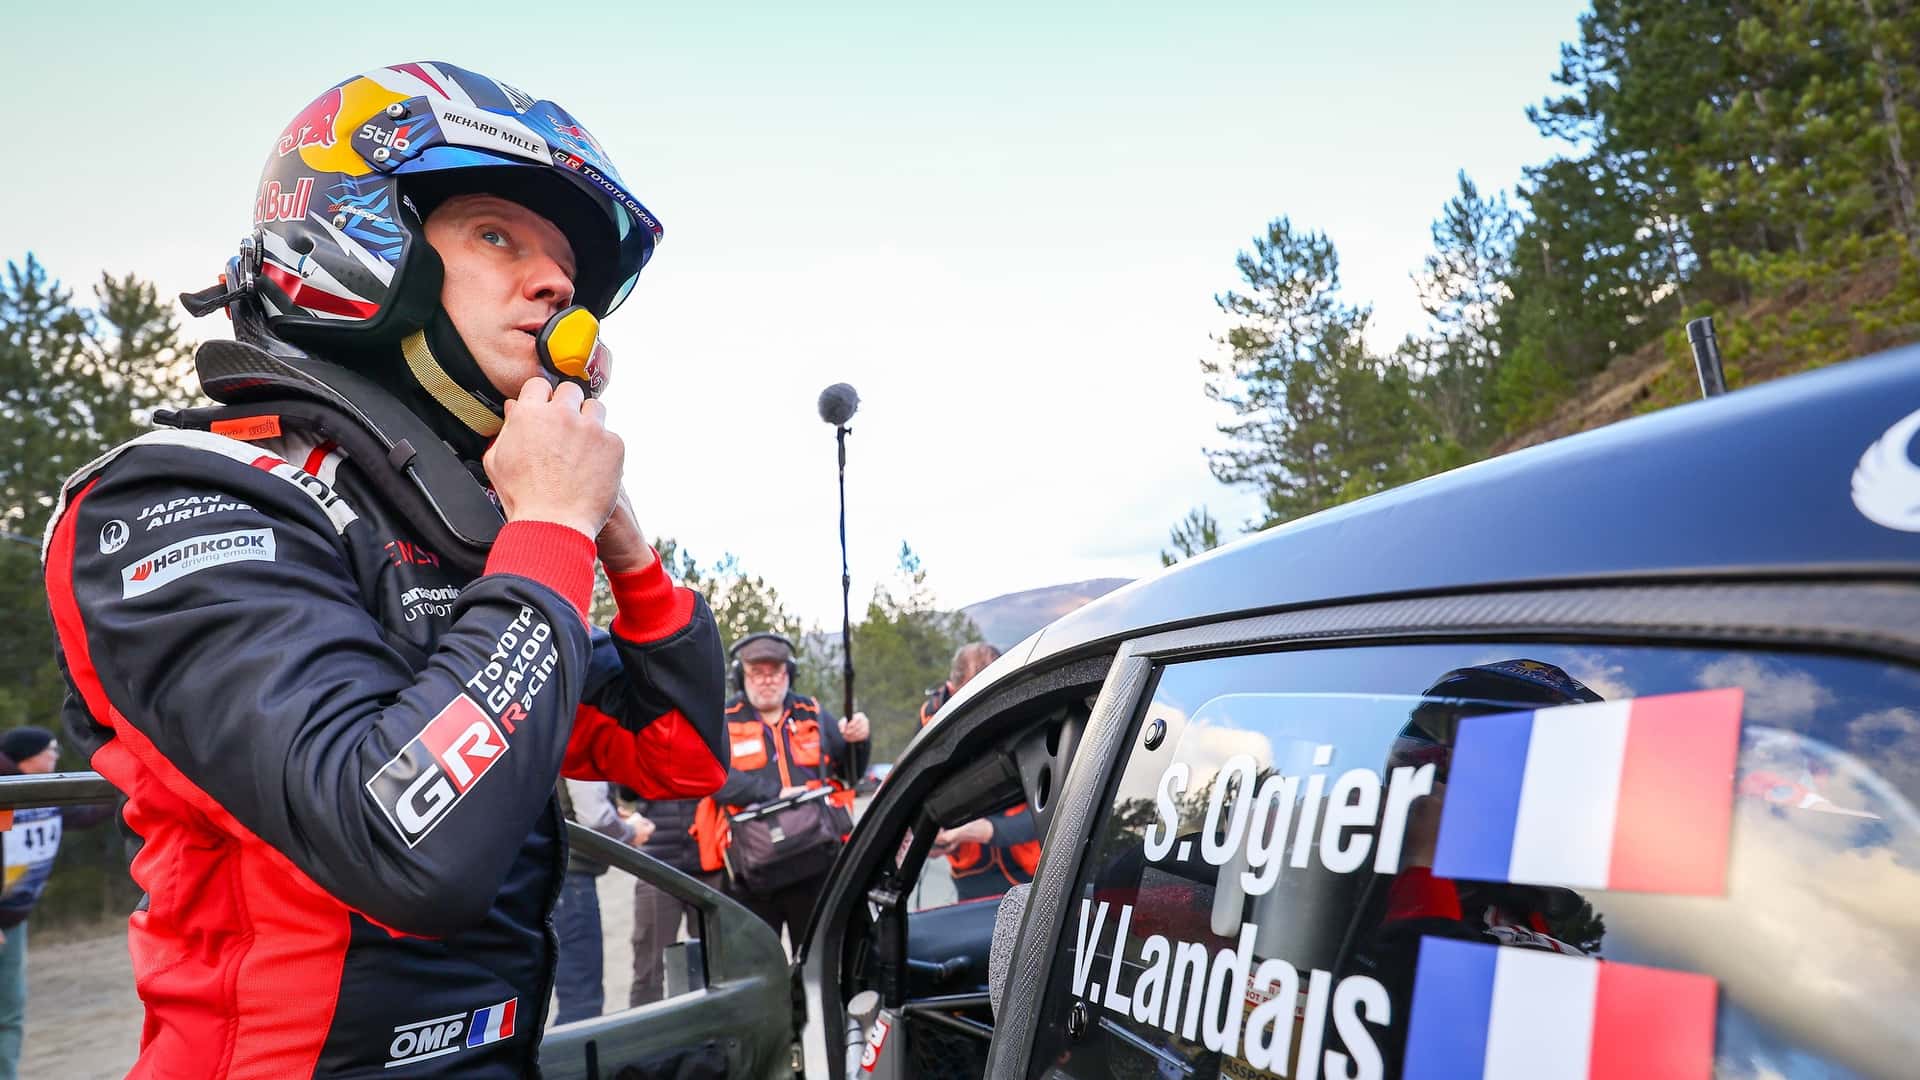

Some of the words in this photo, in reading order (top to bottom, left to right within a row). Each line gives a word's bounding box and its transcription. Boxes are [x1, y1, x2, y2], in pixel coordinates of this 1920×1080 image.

[359, 123, 410, 151] Stilo
[443, 112, 498, 136] RICHARD
[501, 131, 540, 154] MILLE
[553, 151, 581, 170] GR
[583, 166, 627, 201] TOYOTA
[624, 200, 656, 228] GAZOO
[136, 494, 221, 521] JAPAN
[146, 503, 259, 532] AIRLINE
[181, 551, 221, 569] driving
[223, 546, 268, 559] emotion
[466, 605, 534, 693] TOYOTA
[487, 622, 551, 714] GAZOO
[500, 643, 559, 734] Racin
[396, 721, 501, 834] GR
[1143, 744, 1437, 896] S.Ogier
[390, 1020, 464, 1058] OMP
